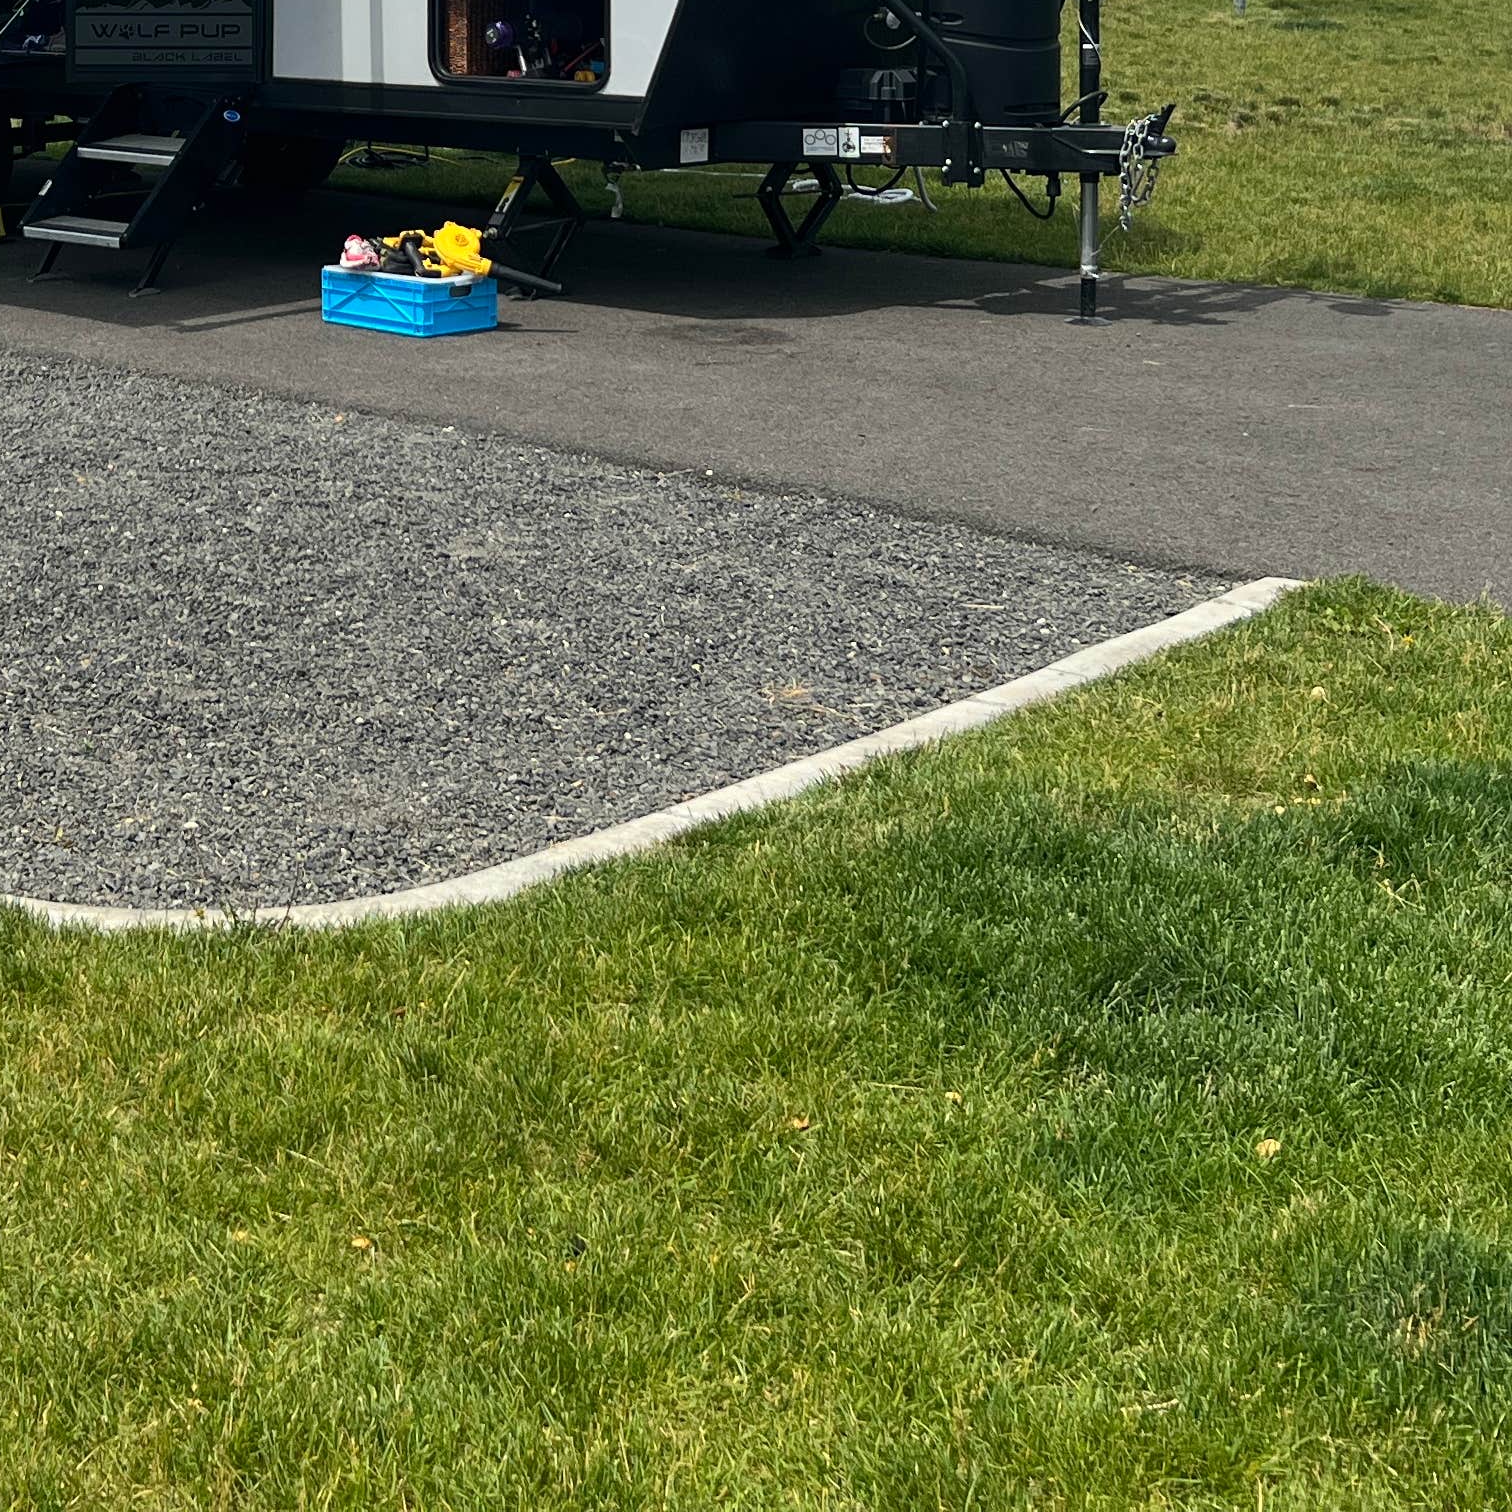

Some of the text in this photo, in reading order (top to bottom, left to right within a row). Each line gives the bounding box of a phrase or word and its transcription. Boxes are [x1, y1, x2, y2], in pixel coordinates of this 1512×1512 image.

[180, 23, 241, 39] PUP
[131, 52, 244, 62] BLACK LABEL
